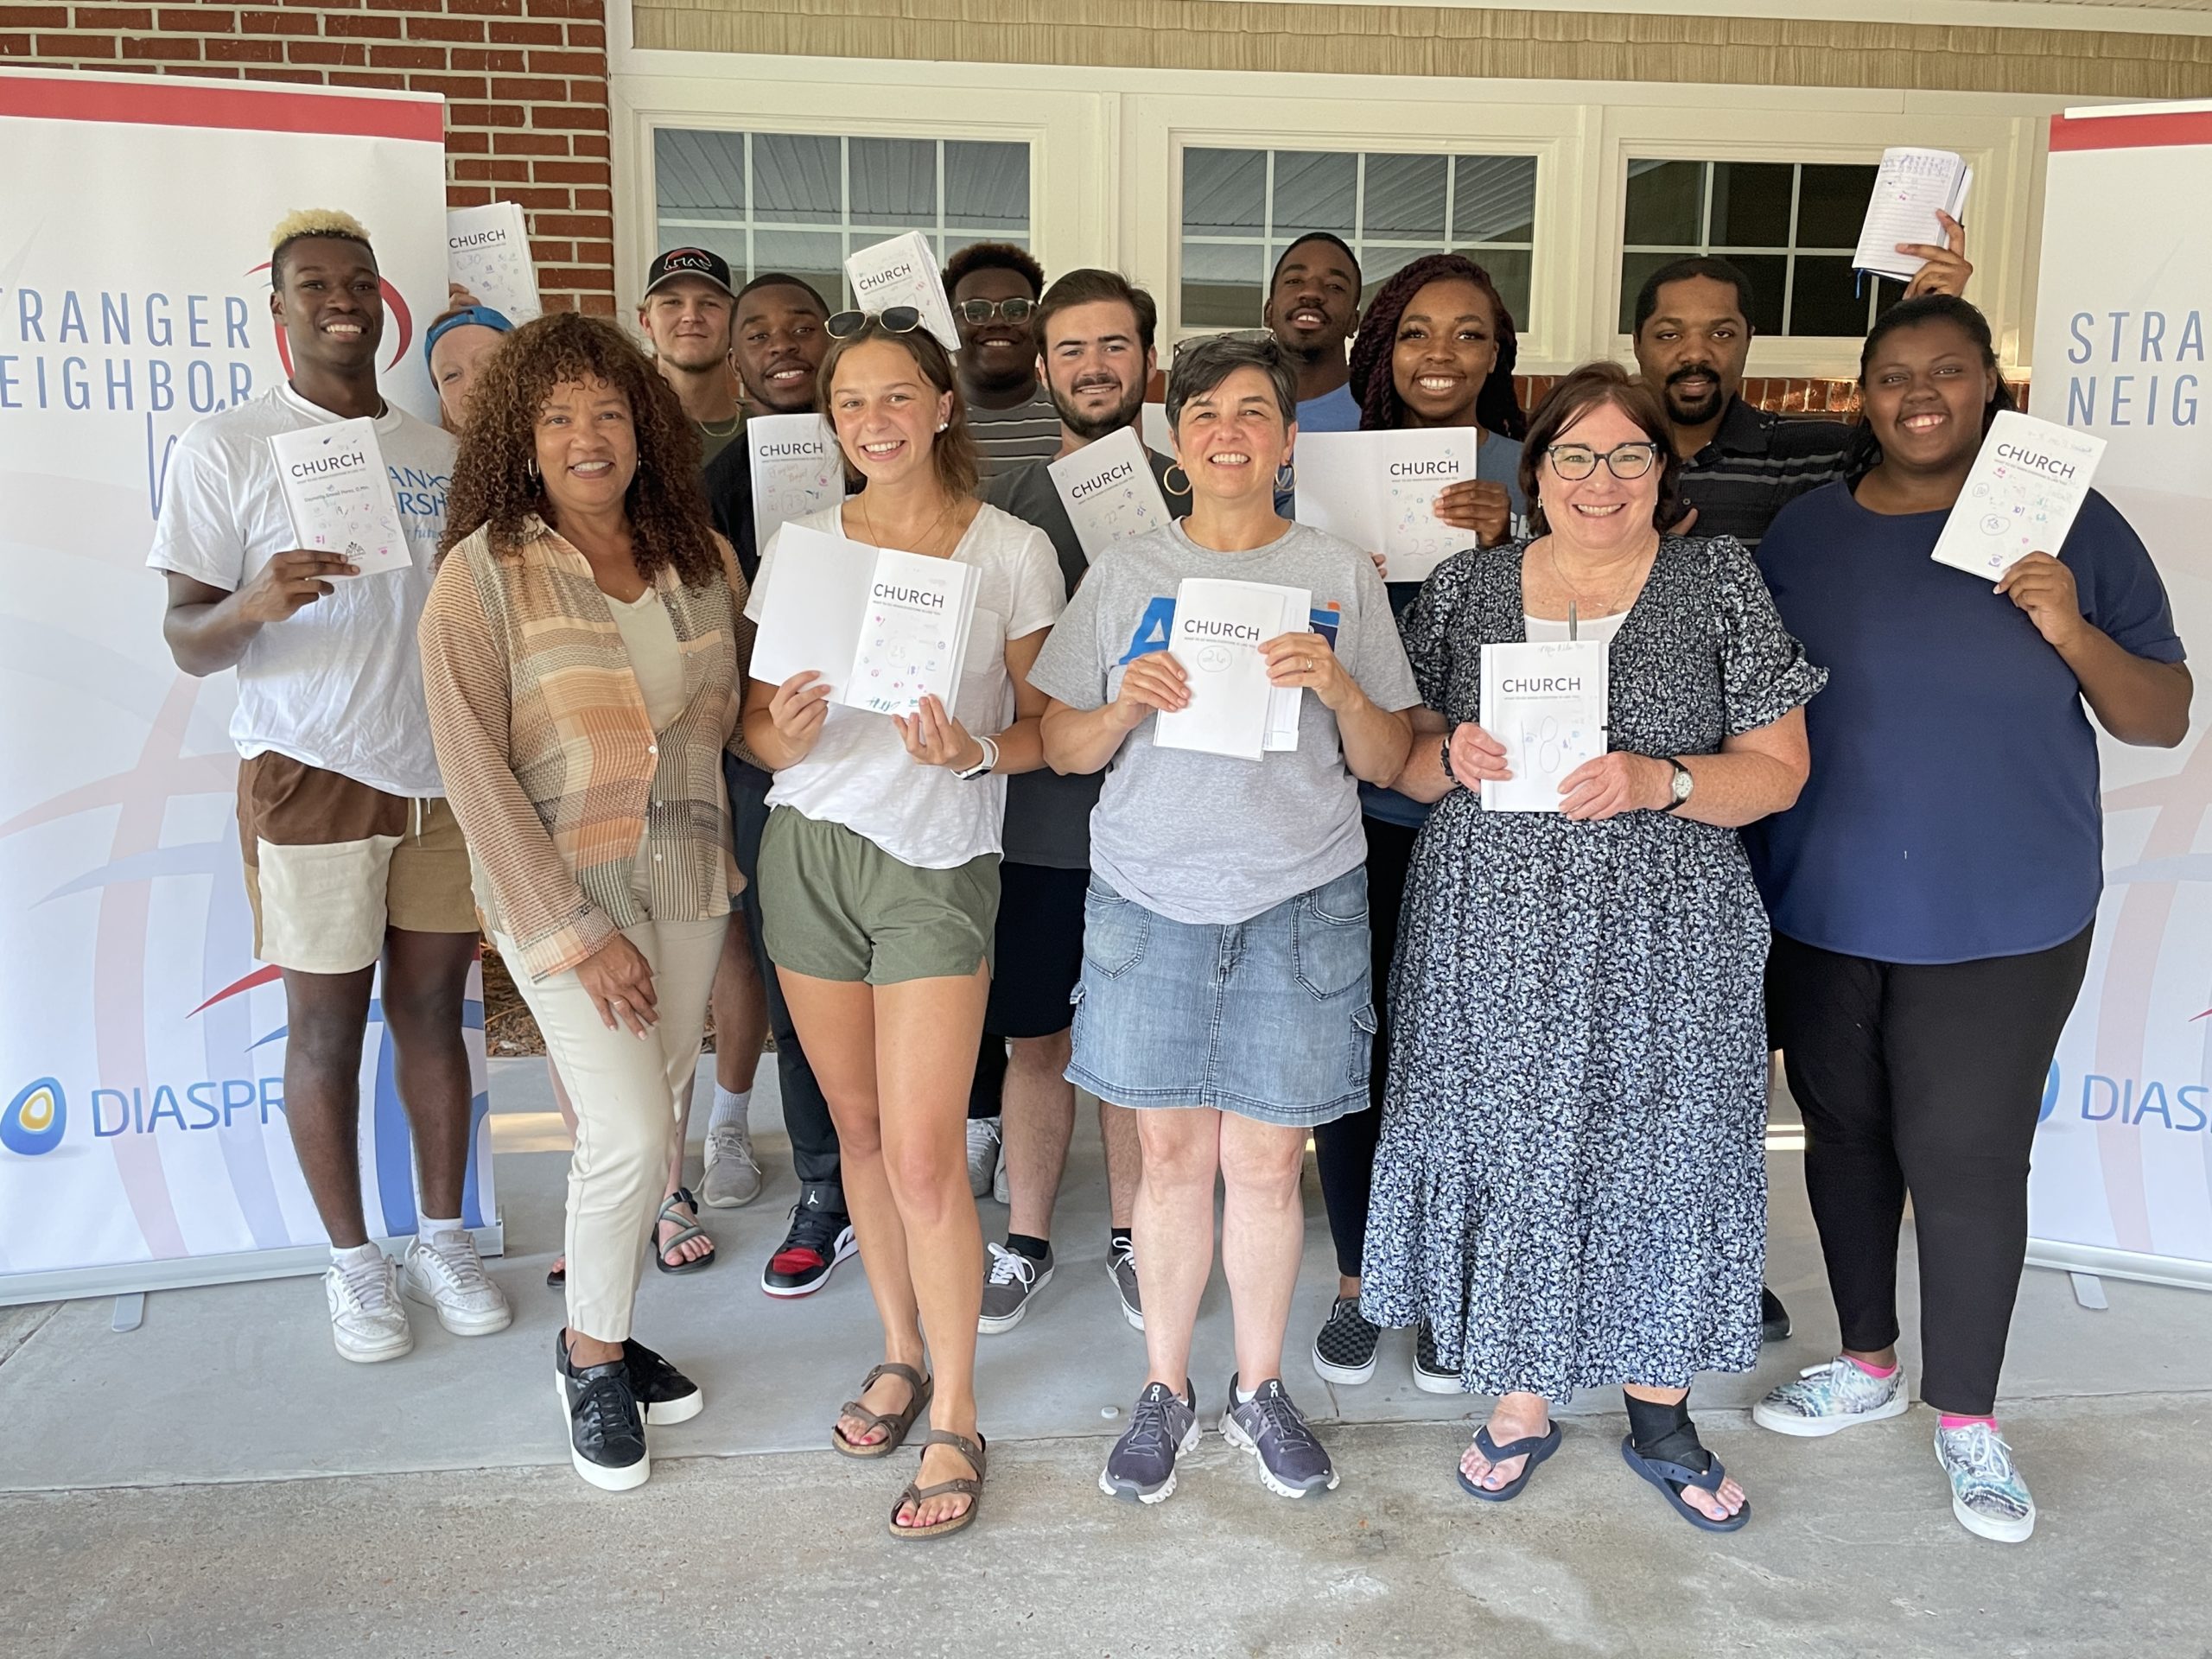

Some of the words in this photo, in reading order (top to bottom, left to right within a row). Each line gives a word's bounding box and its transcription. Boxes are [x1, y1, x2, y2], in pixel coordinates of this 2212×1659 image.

[449, 229, 506, 249] CHURCH
[859, 263, 912, 290] CHURCH
[0, 288, 251, 348] RANGER
[2068, 310, 2205, 365] STRA
[2067, 374, 2198, 426] NEIG
[760, 442, 823, 457] CHURCH
[1997, 443, 2075, 479] CHURCH
[291, 451, 365, 477] CHURCH
[1389, 460, 1459, 476] CHURCH
[1071, 461, 1133, 499] CHURCH
[874, 583, 944, 608] CHURCH
[1184, 619, 1260, 641] CHURCH
[1502, 677, 1581, 692] CHURCH
[2081, 1074, 2212, 1135] DIAS
